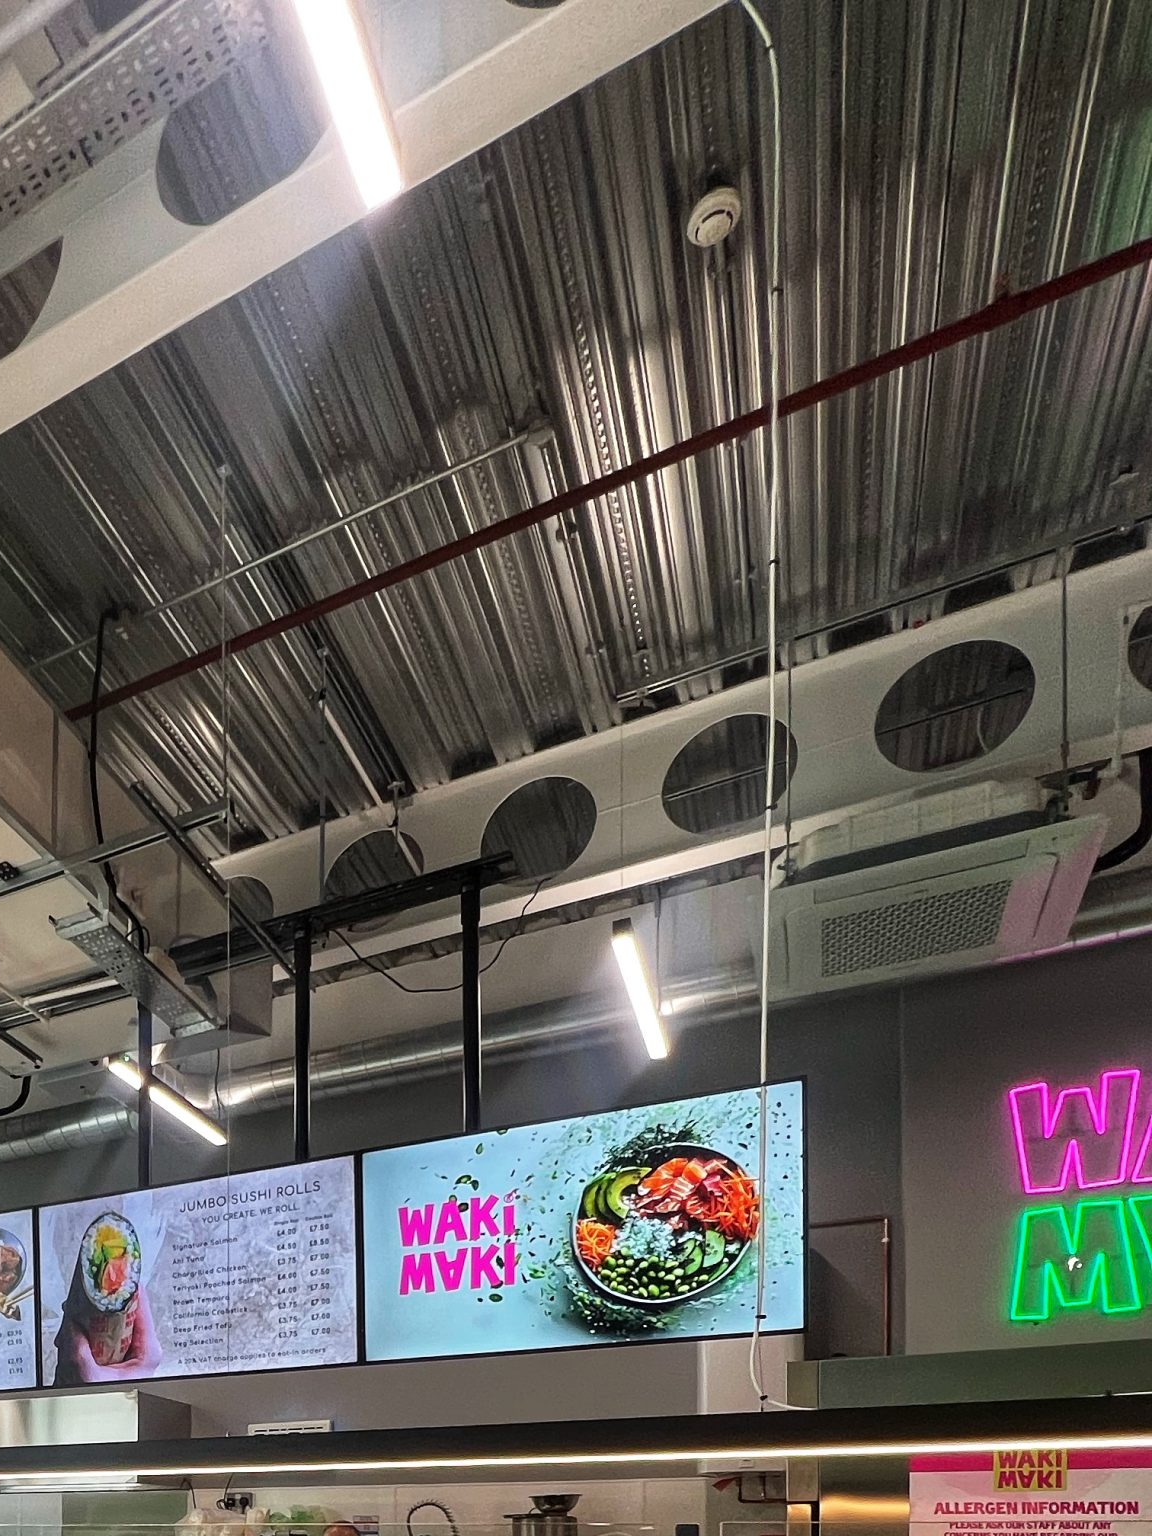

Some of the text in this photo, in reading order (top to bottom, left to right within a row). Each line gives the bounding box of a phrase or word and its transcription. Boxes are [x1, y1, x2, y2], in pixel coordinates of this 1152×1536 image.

[1008, 1068, 1152, 1194] W
[179, 1180, 321, 1213] JUMBO SUSHI ROLLS
[202, 1215, 220, 1225] YOU
[260, 1206, 273, 1216] WE
[210, 1237, 238, 1246] Salmon
[1009, 1195, 1152, 1321] M
[216, 1264, 247, 1274] Chicken
[238, 1276, 266, 1285] Salmon
[193, 1324, 213, 1332] Fried
[934, 1500, 1140, 1515] ALLERGEN INFORMATION
[949, 1521, 1111, 1530] PLEASE ASK OUR STAFF ABOUT ANY
